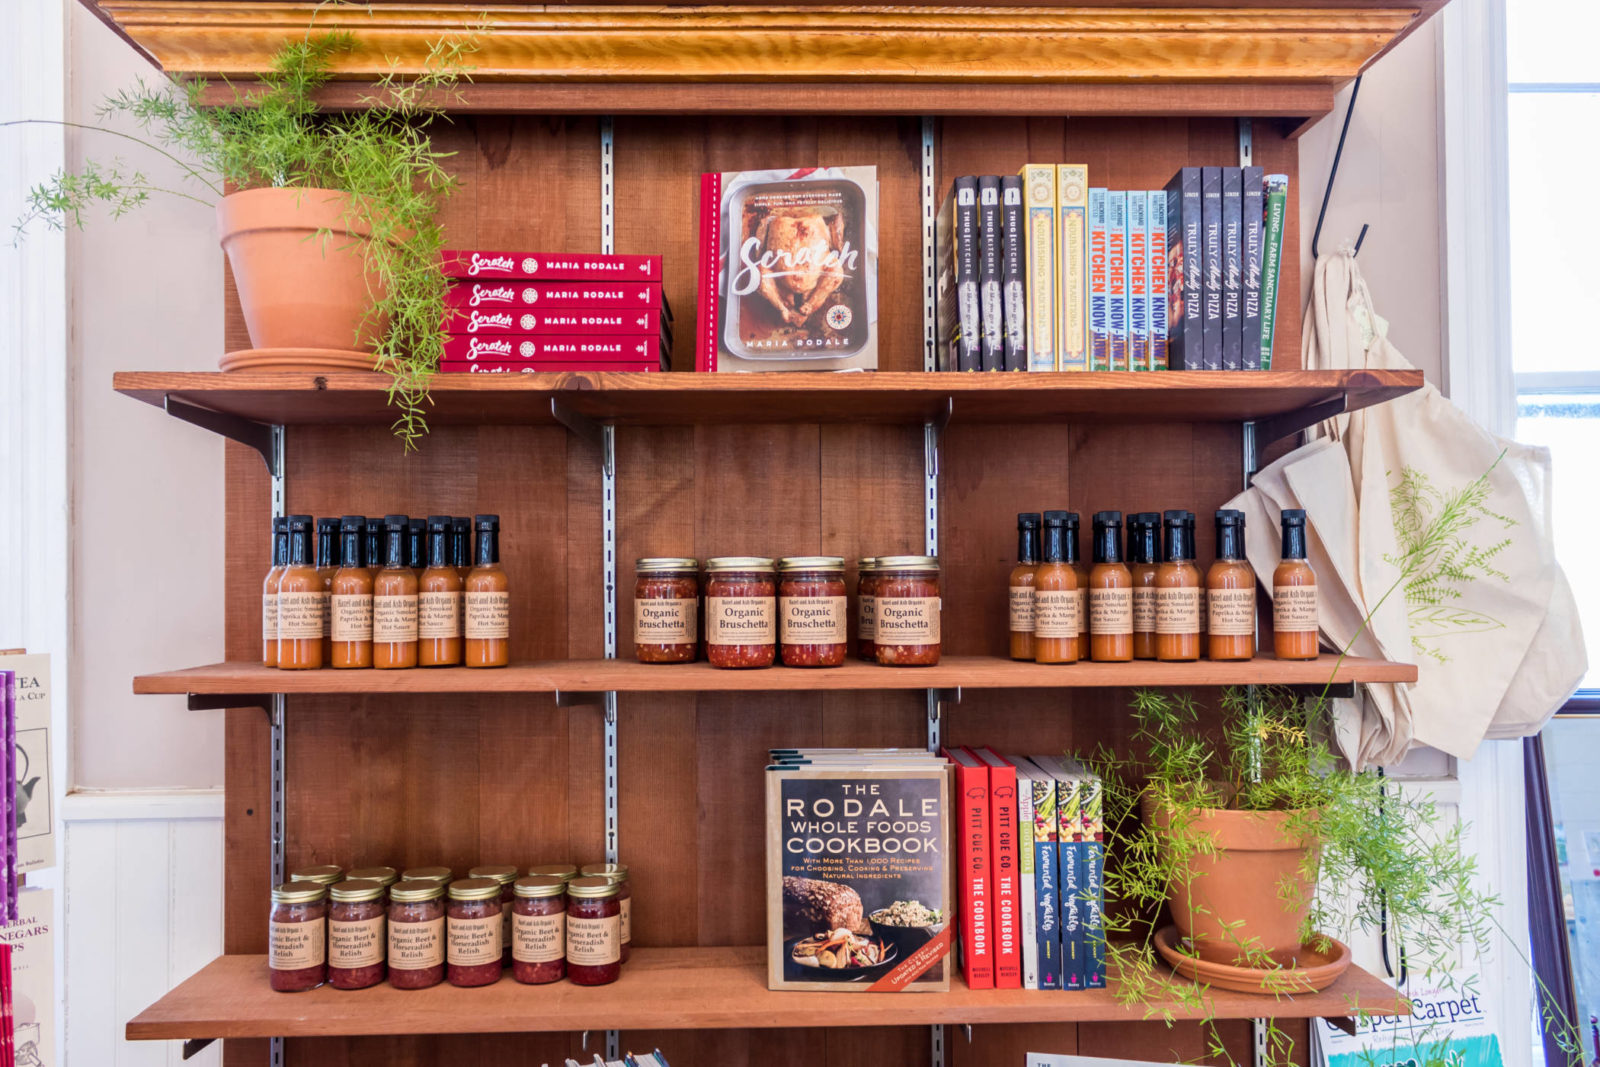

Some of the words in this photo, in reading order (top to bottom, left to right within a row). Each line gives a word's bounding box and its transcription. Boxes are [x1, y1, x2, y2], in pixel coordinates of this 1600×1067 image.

[1272, 202, 1281, 233] LIVING
[1188, 222, 1196, 256] TRULY
[1208, 222, 1218, 258] TRULY
[1228, 220, 1236, 256] TRULY
[1248, 220, 1258, 256] TRULY
[468, 252, 514, 276] Scratch
[732, 236, 858, 296] Scratch
[1092, 231, 1106, 293] KITCHEN
[1110, 233, 1124, 294] KITCHEN
[1131, 233, 1145, 294] KITCHEN
[1152, 232, 1166, 294] KITCHEN
[1268, 242, 1278, 269] FARM
[469, 284, 514, 306] Scratch
[1188, 292, 1199, 319] PIZZA
[1226, 292, 1238, 319] PIZZA
[1246, 292, 1258, 318] PIZZA
[1264, 269, 1276, 320] SANCTUARY
[1208, 293, 1220, 320] PIZZA
[467, 310, 513, 333] Scratch
[1092, 296, 1106, 358] KNOW-HOW
[1110, 298, 1124, 360] KNOW-HOW
[1132, 298, 1146, 359] KNOW-HOW
[1152, 297, 1166, 358] KNOW-HOW
[1262, 320, 1270, 340] LIFE
[466, 337, 512, 360] Scratch
[797, 338, 849, 346] RODALE
[639, 620, 684, 628] Bruschetta
[642, 608, 679, 619] Organic
[720, 620, 768, 628] Bruschetta
[724, 608, 764, 618] Organic
[787, 619, 836, 628] Bruschetta
[791, 608, 830, 618] Organic
[880, 620, 928, 628] Bruschetta
[884, 608, 923, 619] Organic
[842, 784, 880, 796] THE
[787, 798, 938, 817] RODALE
[972, 808, 982, 828] PITT
[1000, 806, 1010, 828] PITT
[1021, 794, 1032, 820] Apple
[790, 822, 858, 834] WHOLE
[867, 822, 932, 834] FOODS
[787, 838, 938, 854] COOKBOOK
[972, 833, 983, 852] CUE
[1000, 832, 1010, 851] CUE
[972, 857, 984, 874] CO.
[1000, 856, 1011, 872] CO.
[973, 877, 984, 896] THE
[1000, 876, 1012, 896] THE
[514, 926, 537, 936] Organic
[518, 934, 556, 942] Horseradish
[974, 900, 986, 956] COOKBOOK
[1001, 899, 1013, 954] COOKBOOK
[390, 936, 413, 944] Organic
[393, 942, 433, 950] Horseradish
[891, 964, 916, 984] UPDATED
[920, 942, 944, 962] REVISED
[1412, 994, 1481, 1023] Carpet
